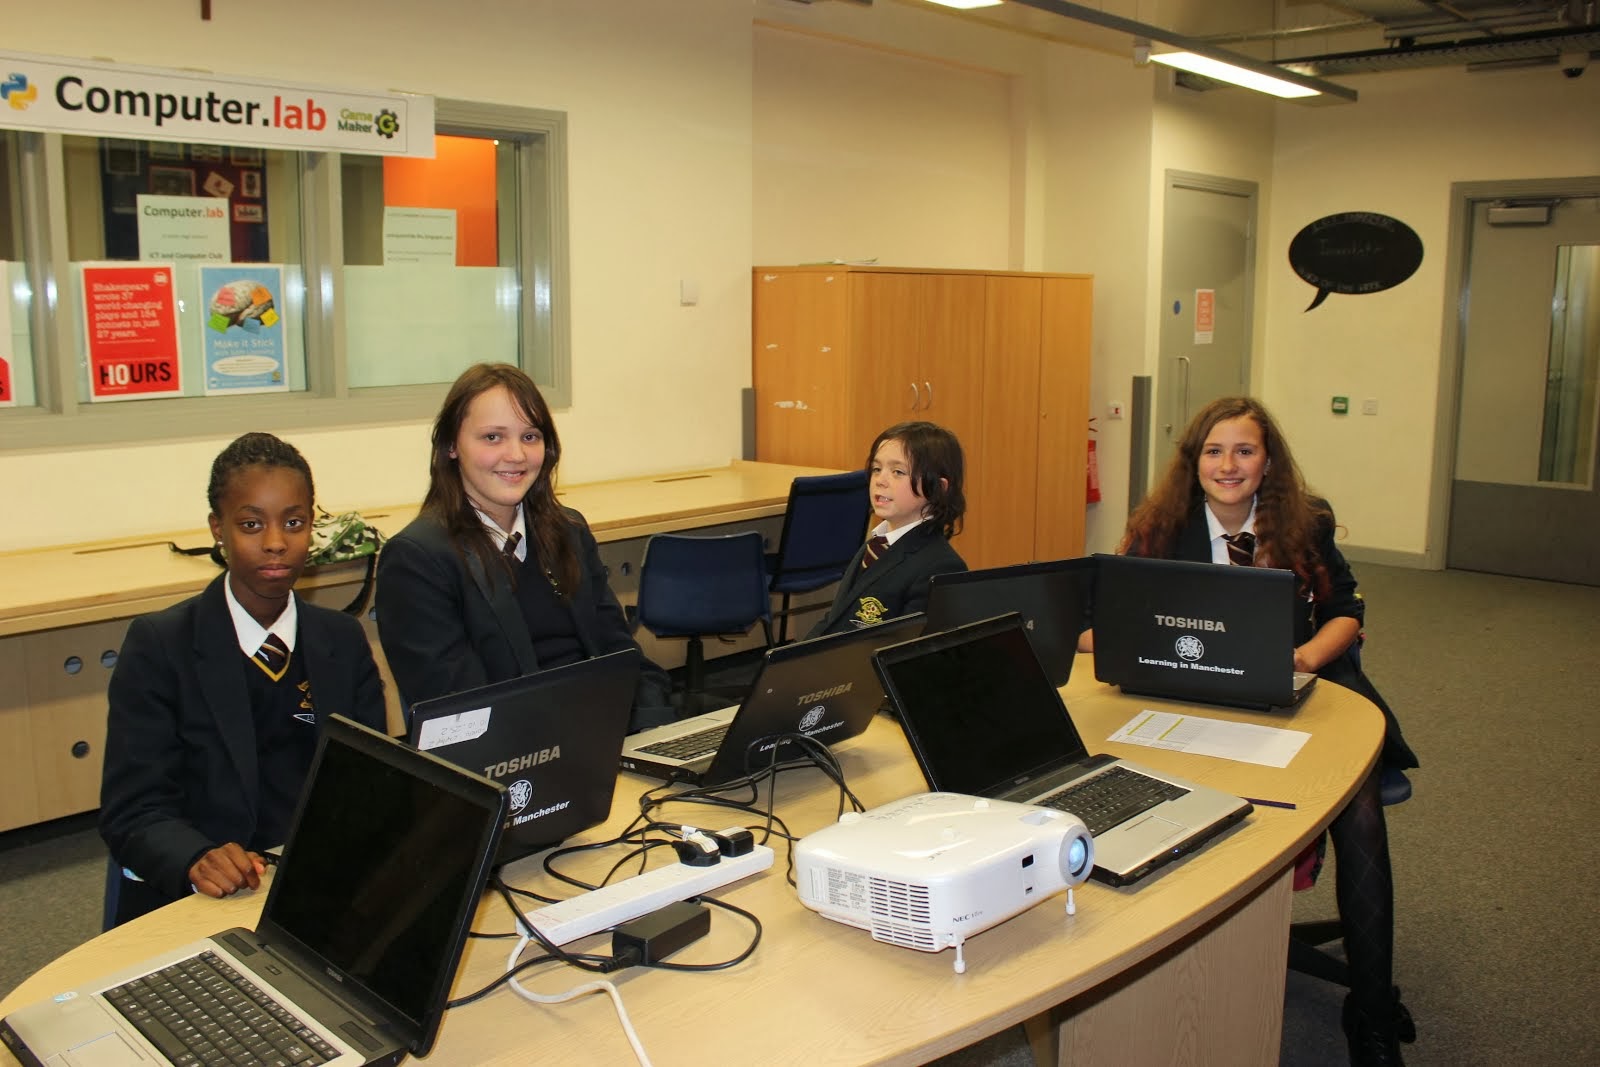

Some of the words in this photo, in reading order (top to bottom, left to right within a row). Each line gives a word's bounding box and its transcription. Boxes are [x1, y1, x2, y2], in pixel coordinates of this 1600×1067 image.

[54, 75, 327, 132] Computer.lab
[340, 108, 373, 121] Game
[337, 120, 373, 133] Maker
[143, 205, 225, 219] Computer.lab
[175, 252, 207, 260] Computer
[93, 283, 150, 292] Shakespeare
[121, 310, 138, 319] and
[99, 361, 172, 385] HOURS
[1154, 615, 1226, 632] TOSHIBA
[1139, 657, 1178, 669] Learning
[1190, 663, 1245, 675] Manchester
[797, 682, 853, 706] TOSHIBA
[804, 721, 845, 737] Manchester
[484, 745, 561, 779] TOSHIBA
[512, 800, 570, 827] Manchester
[952, 913, 971, 923] NEC
